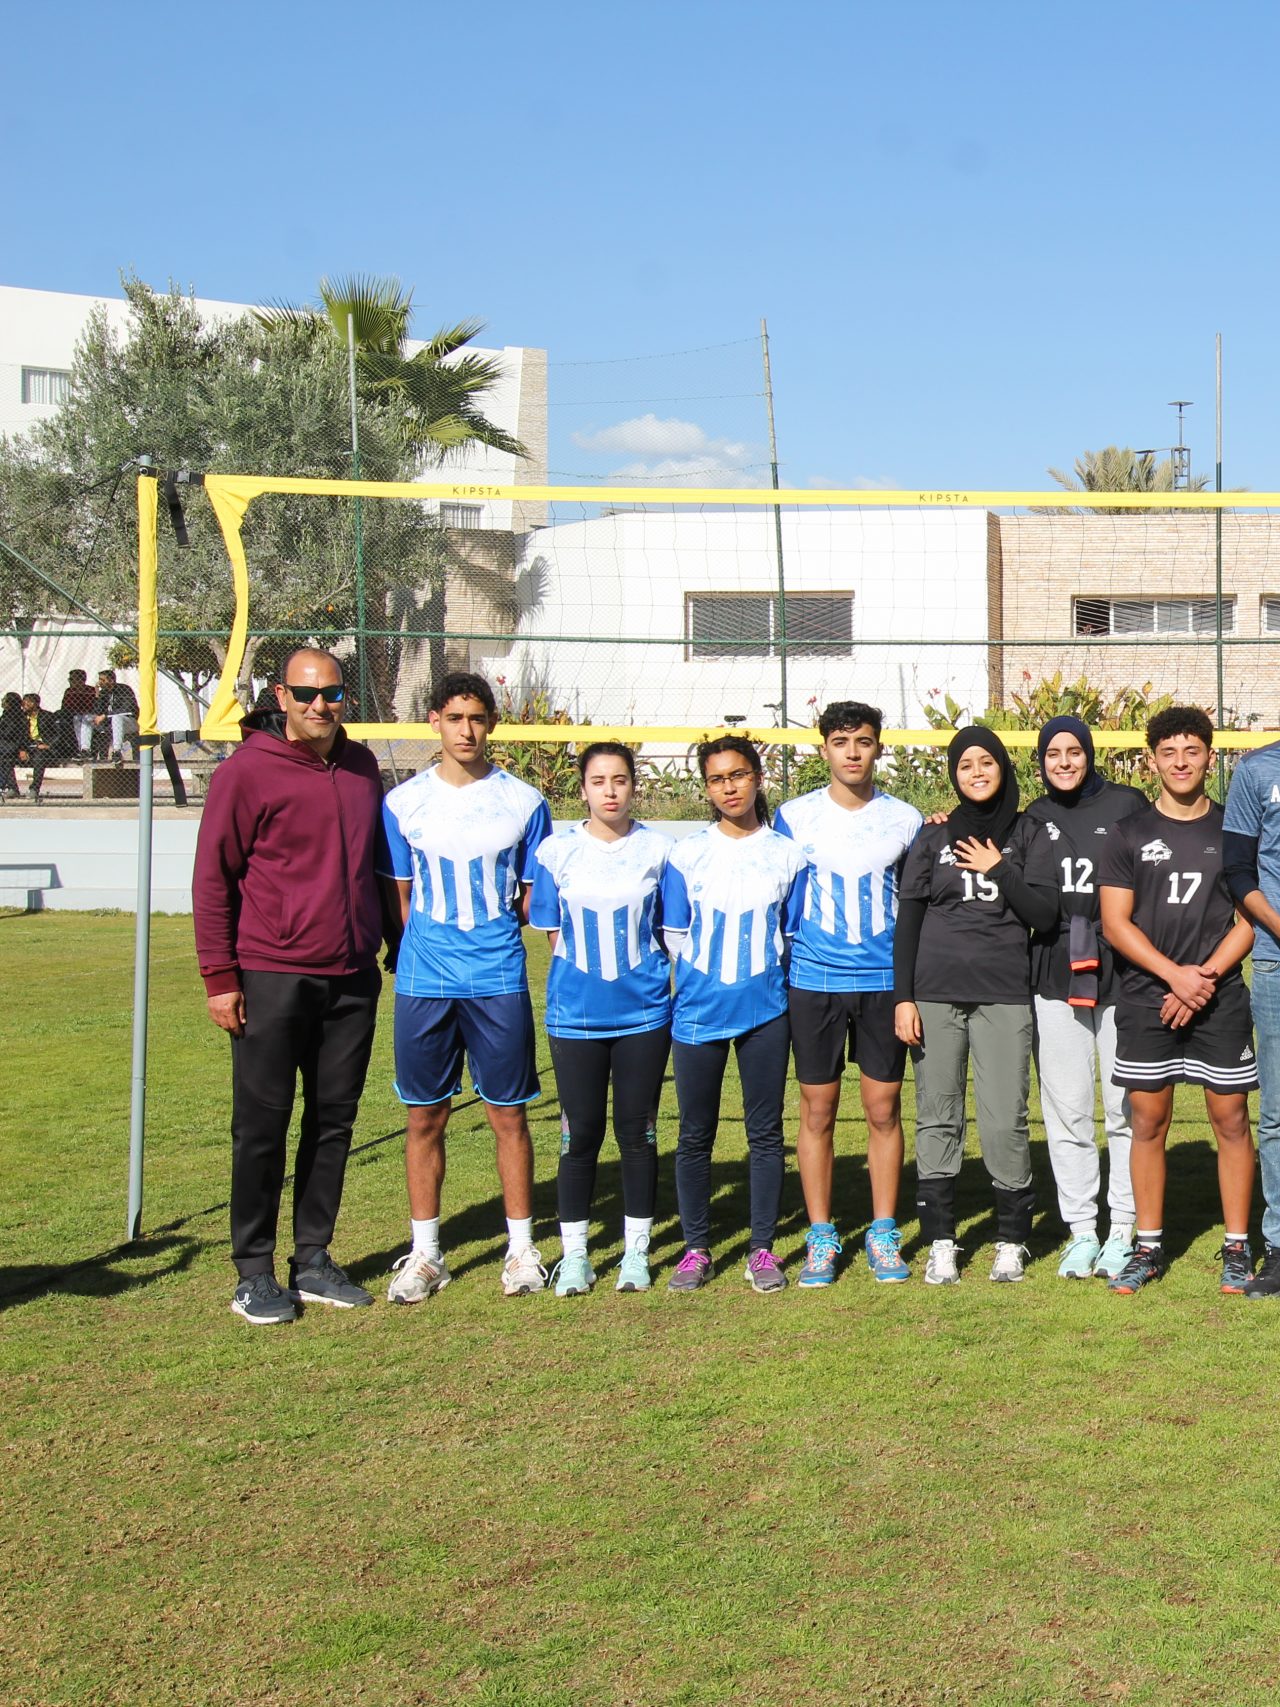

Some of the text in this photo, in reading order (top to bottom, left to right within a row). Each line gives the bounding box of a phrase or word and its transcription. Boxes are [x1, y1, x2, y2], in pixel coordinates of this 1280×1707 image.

[452, 486, 501, 495] KIPSTA
[919, 493, 968, 502] KIPSTA
[961, 869, 999, 902] 15
[1061, 857, 1094, 893] 12
[1167, 871, 1202, 904] 17
